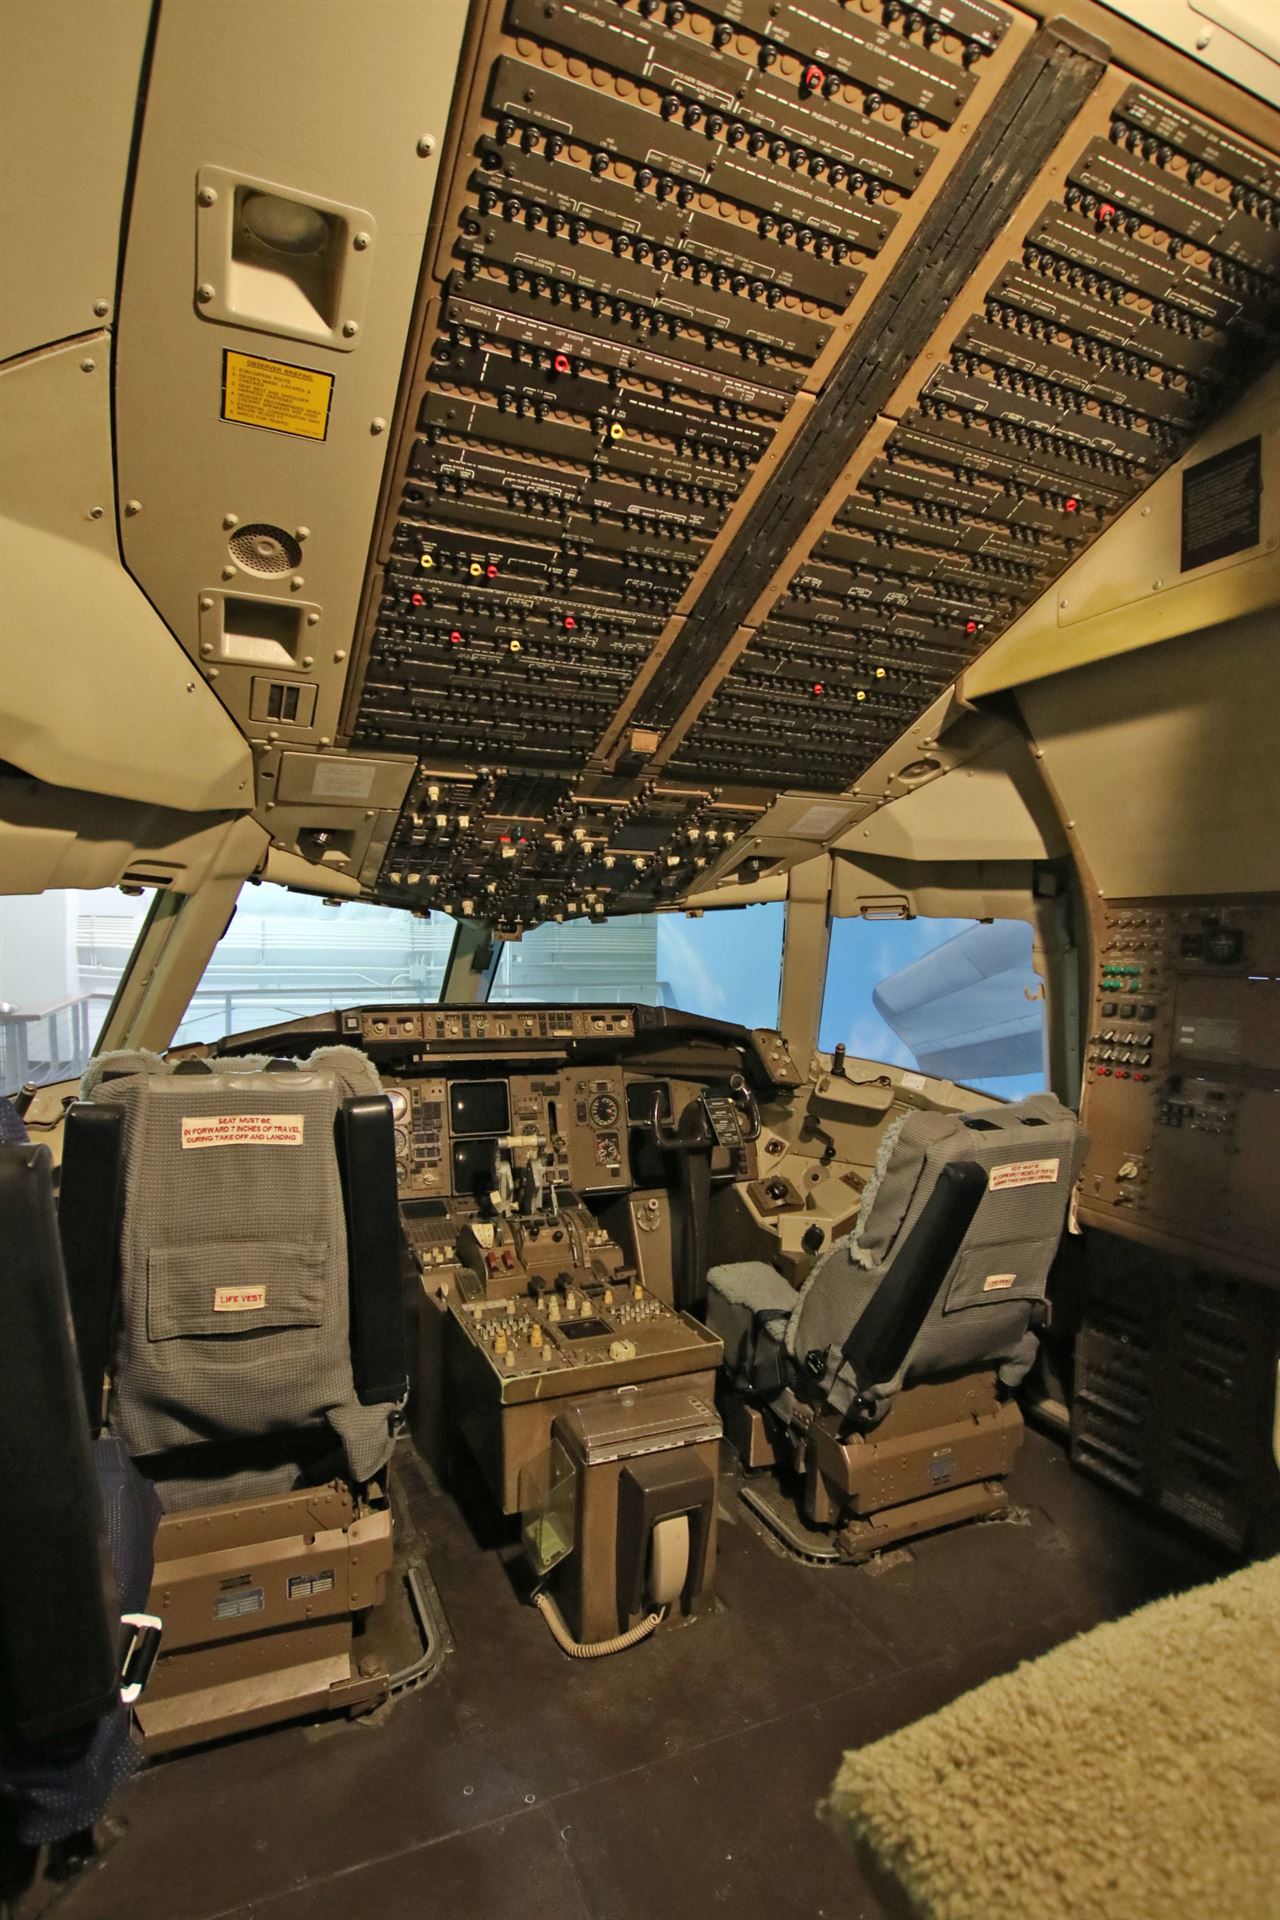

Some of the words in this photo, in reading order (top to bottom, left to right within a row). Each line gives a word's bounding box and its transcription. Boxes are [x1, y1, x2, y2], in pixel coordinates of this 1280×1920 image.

[246, 359, 281, 372] OBSERVER
[284, 368, 312, 379] BRIEFING
[192, 1127, 229, 1135] FORWARD
[187, 1135, 213, 1143] DURING
